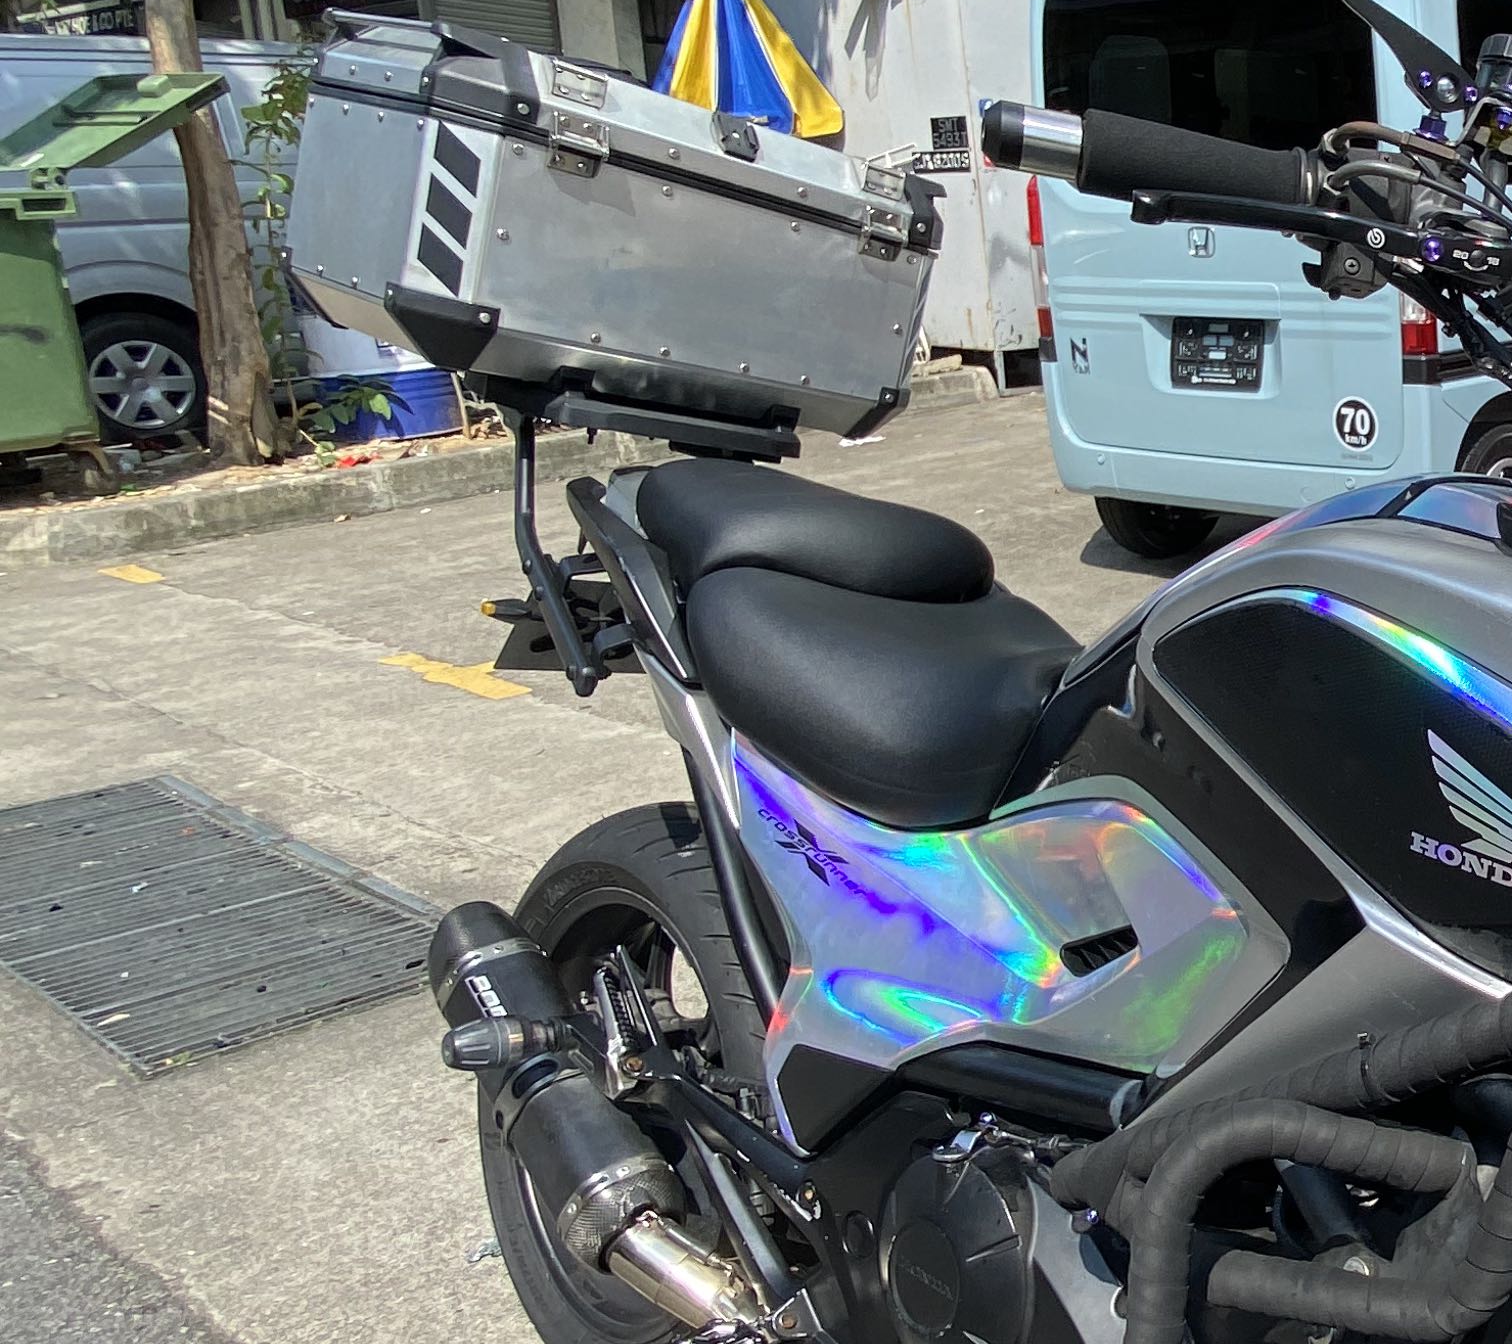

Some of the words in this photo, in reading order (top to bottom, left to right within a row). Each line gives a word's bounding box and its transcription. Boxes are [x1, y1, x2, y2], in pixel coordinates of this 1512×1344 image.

[1340, 407, 1371, 436] 70
[1344, 433, 1368, 446] km/h
[758, 808, 867, 897] crossrunner
